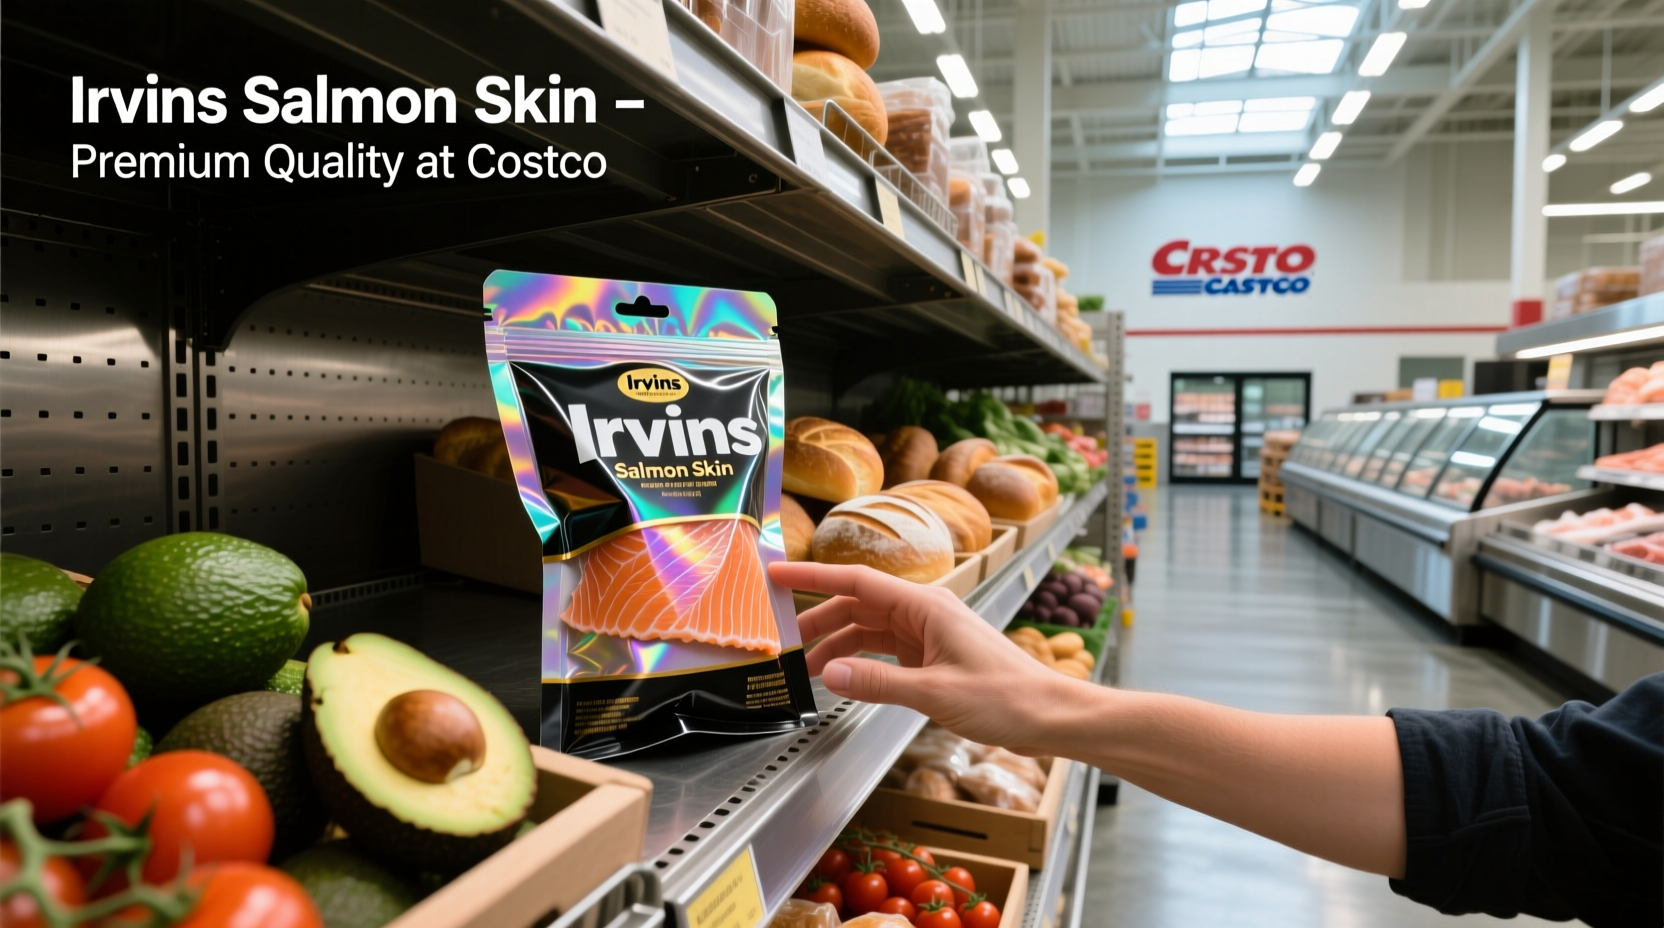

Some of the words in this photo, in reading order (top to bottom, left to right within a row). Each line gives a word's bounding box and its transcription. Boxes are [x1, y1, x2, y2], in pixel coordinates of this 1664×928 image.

[1204, 277, 1310, 295] CASTCO
[627, 374, 682, 390] Irvins
[568, 404, 762, 464] Irvins
[614, 461, 689, 479] Salmon
[691, 460, 734, 477] Skin
